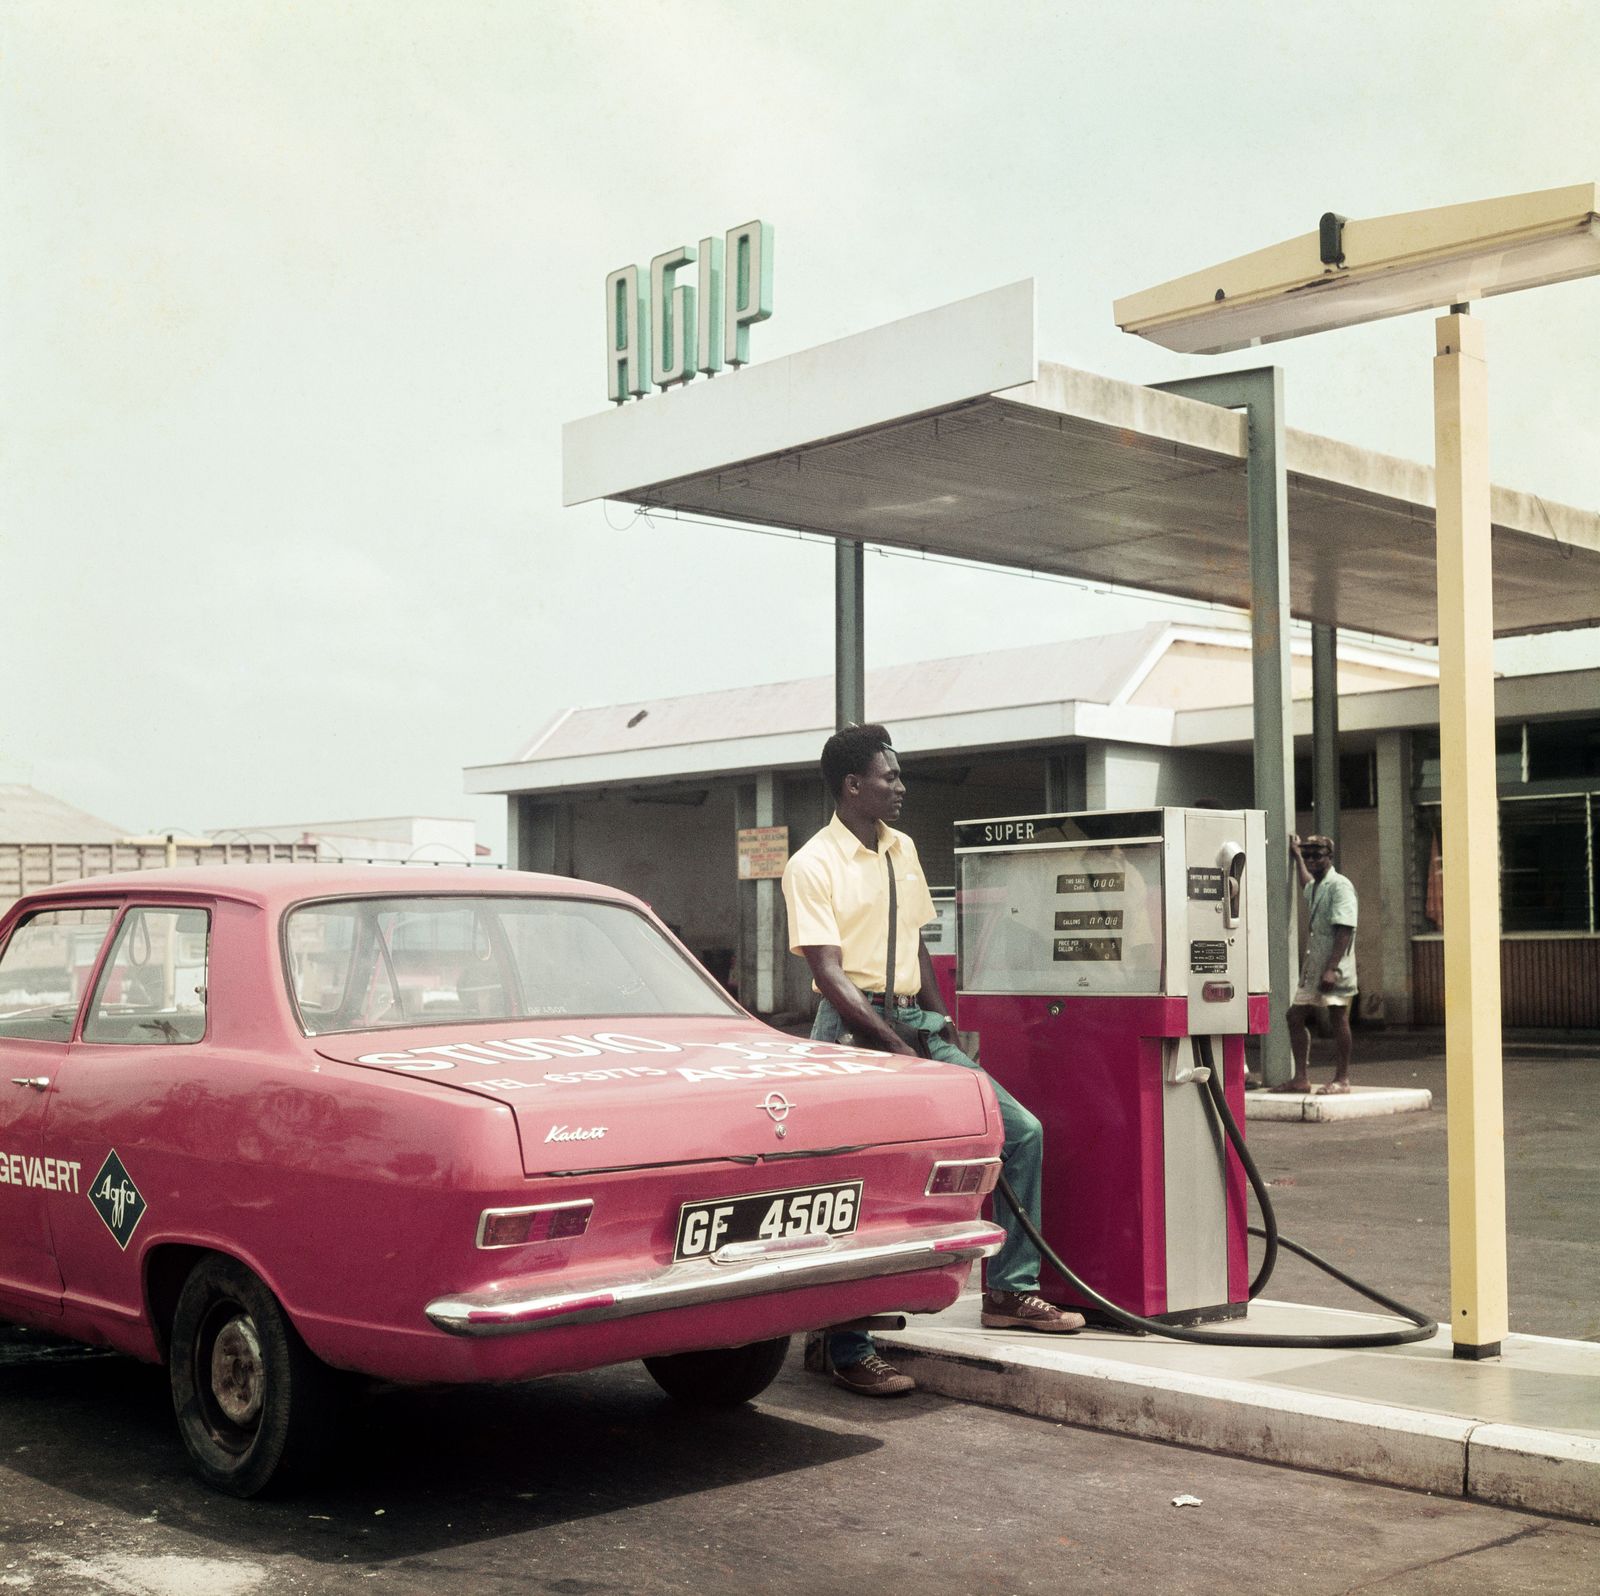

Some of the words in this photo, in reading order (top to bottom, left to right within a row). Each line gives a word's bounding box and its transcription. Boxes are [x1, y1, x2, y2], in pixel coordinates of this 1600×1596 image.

[605, 219, 774, 401] AGIP
[985, 822, 1035, 841] SUPER
[357, 1032, 683, 1071] STUDIO
[675, 1060, 901, 1082] ACCRA
[543, 1066, 668, 1084] 63775
[544, 1125, 609, 1143] Kadett
[0, 1151, 81, 1194] GEVAERT
[95, 1174, 136, 1229] Agfa
[682, 1206, 734, 1255] GF
[759, 1189, 855, 1240] 4506
